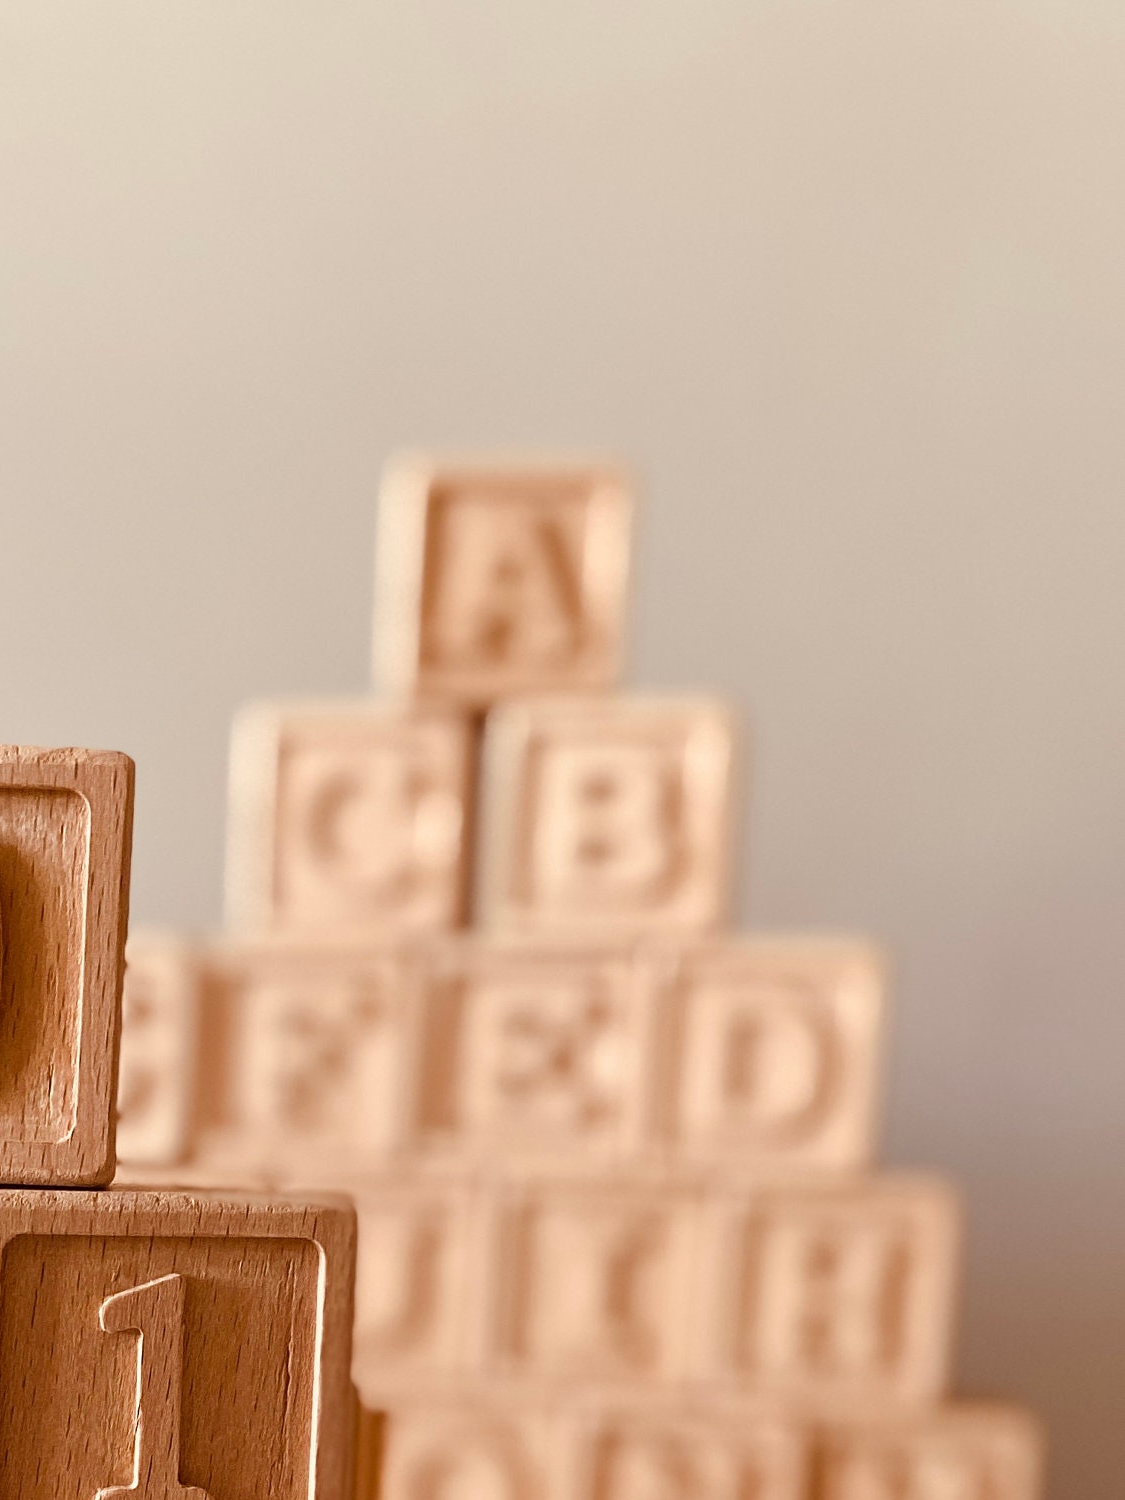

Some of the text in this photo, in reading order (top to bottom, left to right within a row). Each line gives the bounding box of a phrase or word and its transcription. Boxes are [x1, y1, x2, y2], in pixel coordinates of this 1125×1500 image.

[441, 506, 587, 655] A
[547, 748, 675, 898] B
[695, 980, 833, 1140] D
